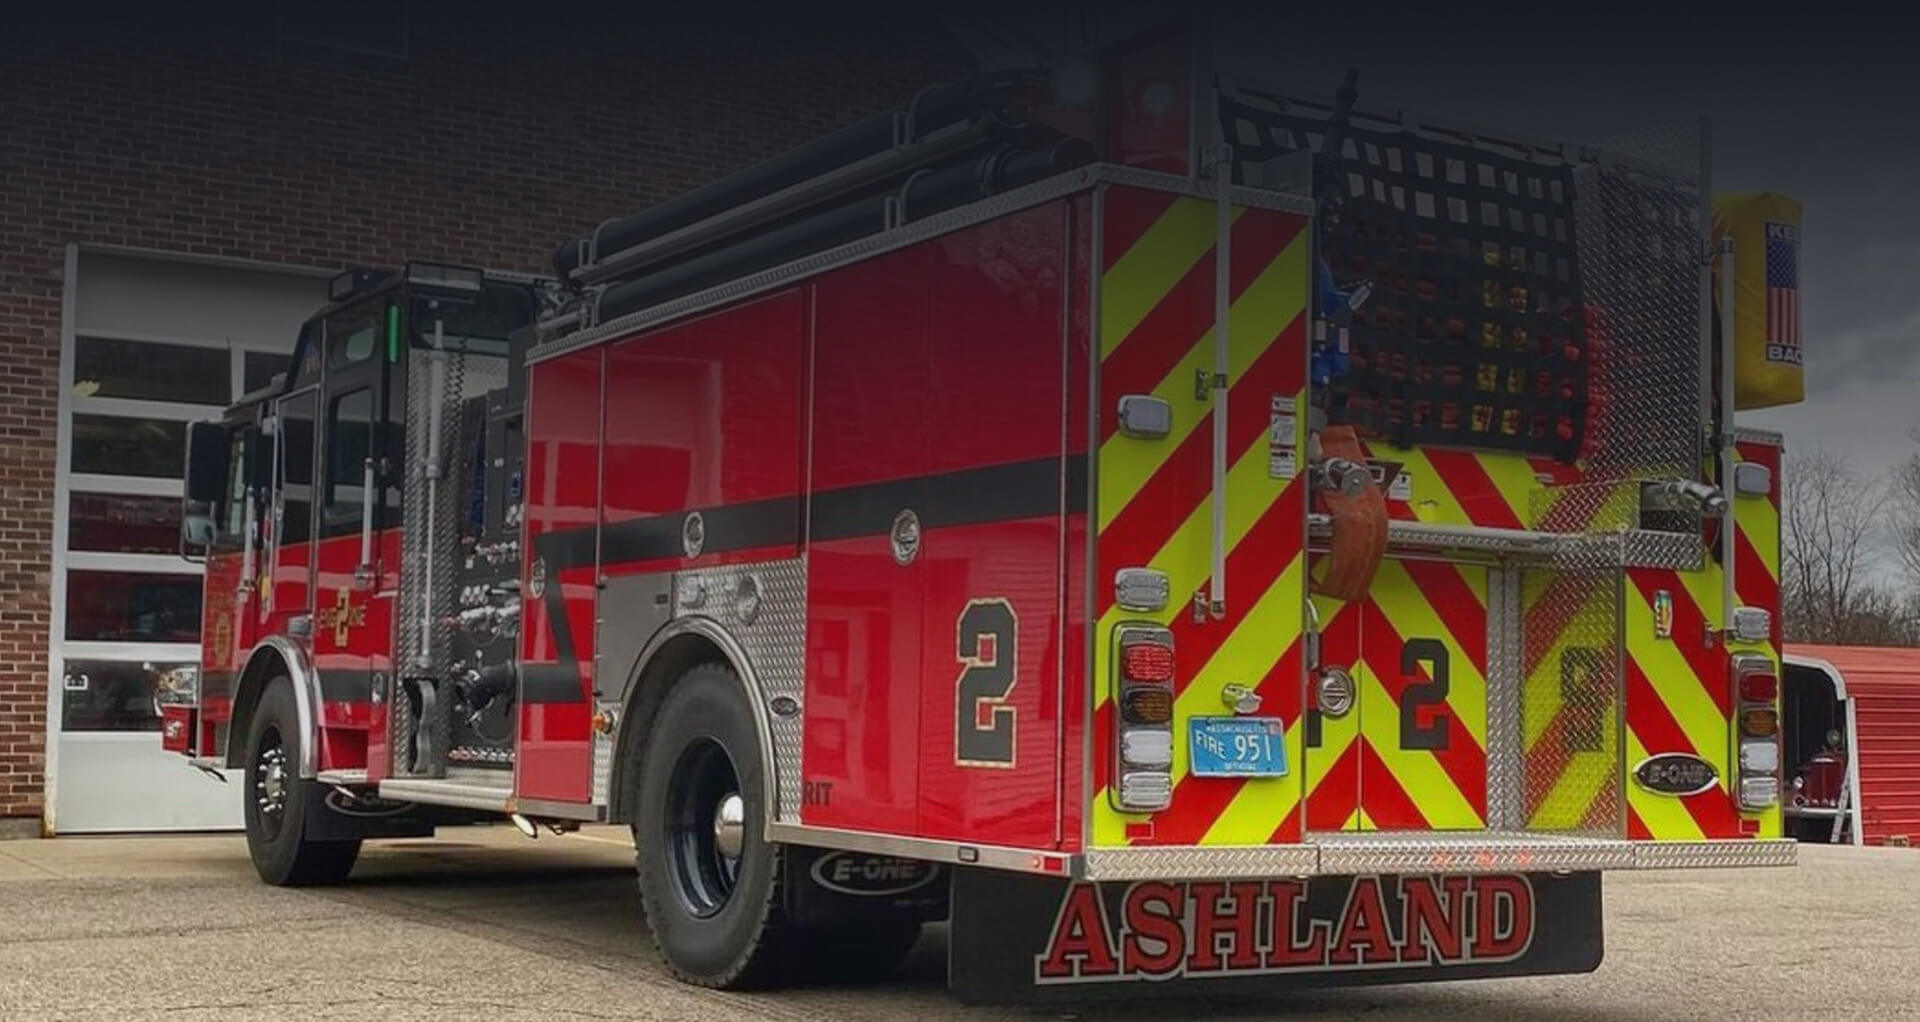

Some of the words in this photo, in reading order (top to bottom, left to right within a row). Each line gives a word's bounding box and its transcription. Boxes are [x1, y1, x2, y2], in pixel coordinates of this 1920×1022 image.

[954, 596, 1019, 770] 2
[1399, 637, 1450, 750] 2
[1194, 729, 1227, 761] FIRE
[1234, 734, 1272, 762] 951
[830, 856, 919, 882] E-ONE
[1035, 872, 1535, 985] ASHLAND
